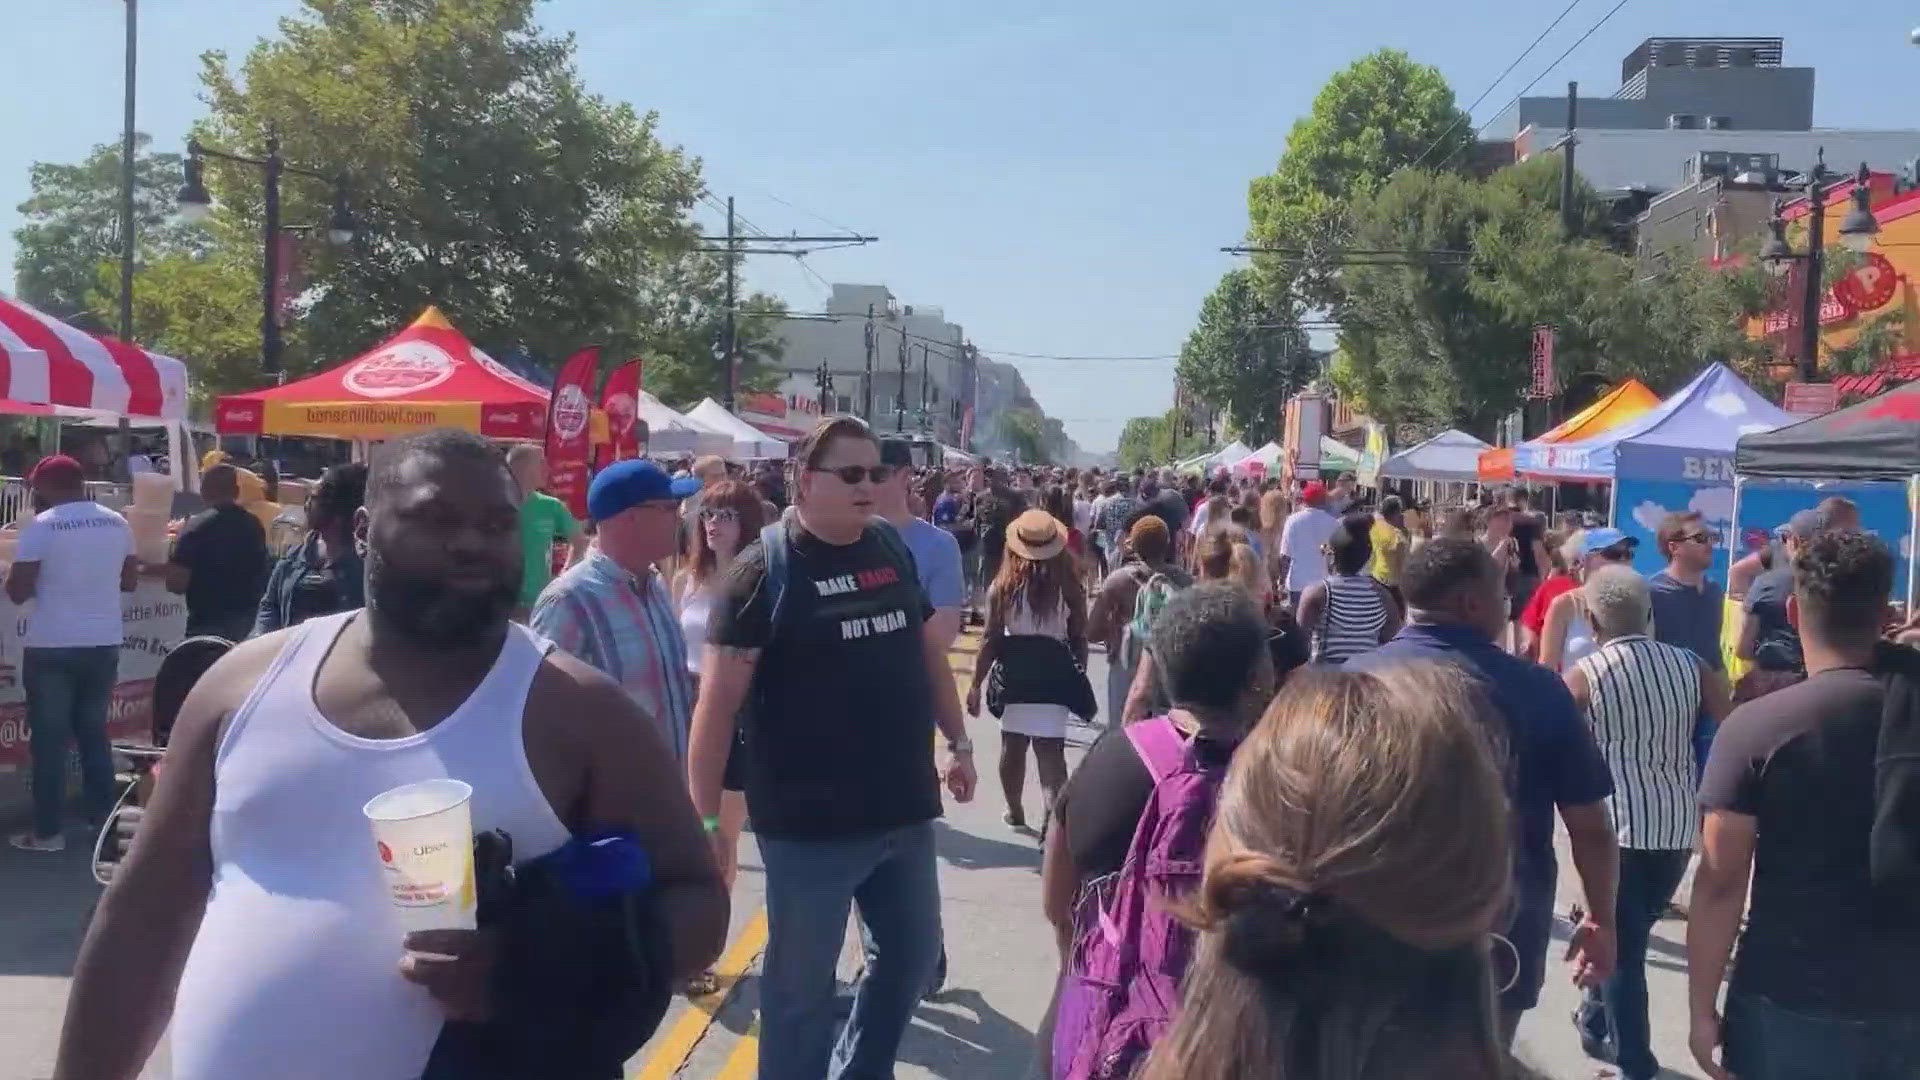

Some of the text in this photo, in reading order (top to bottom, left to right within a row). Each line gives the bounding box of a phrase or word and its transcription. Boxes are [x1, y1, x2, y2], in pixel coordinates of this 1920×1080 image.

[1682, 457, 1735, 481] BEN
[815, 574, 858, 596] MAKE
[841, 609, 907, 640] NOT WAR
